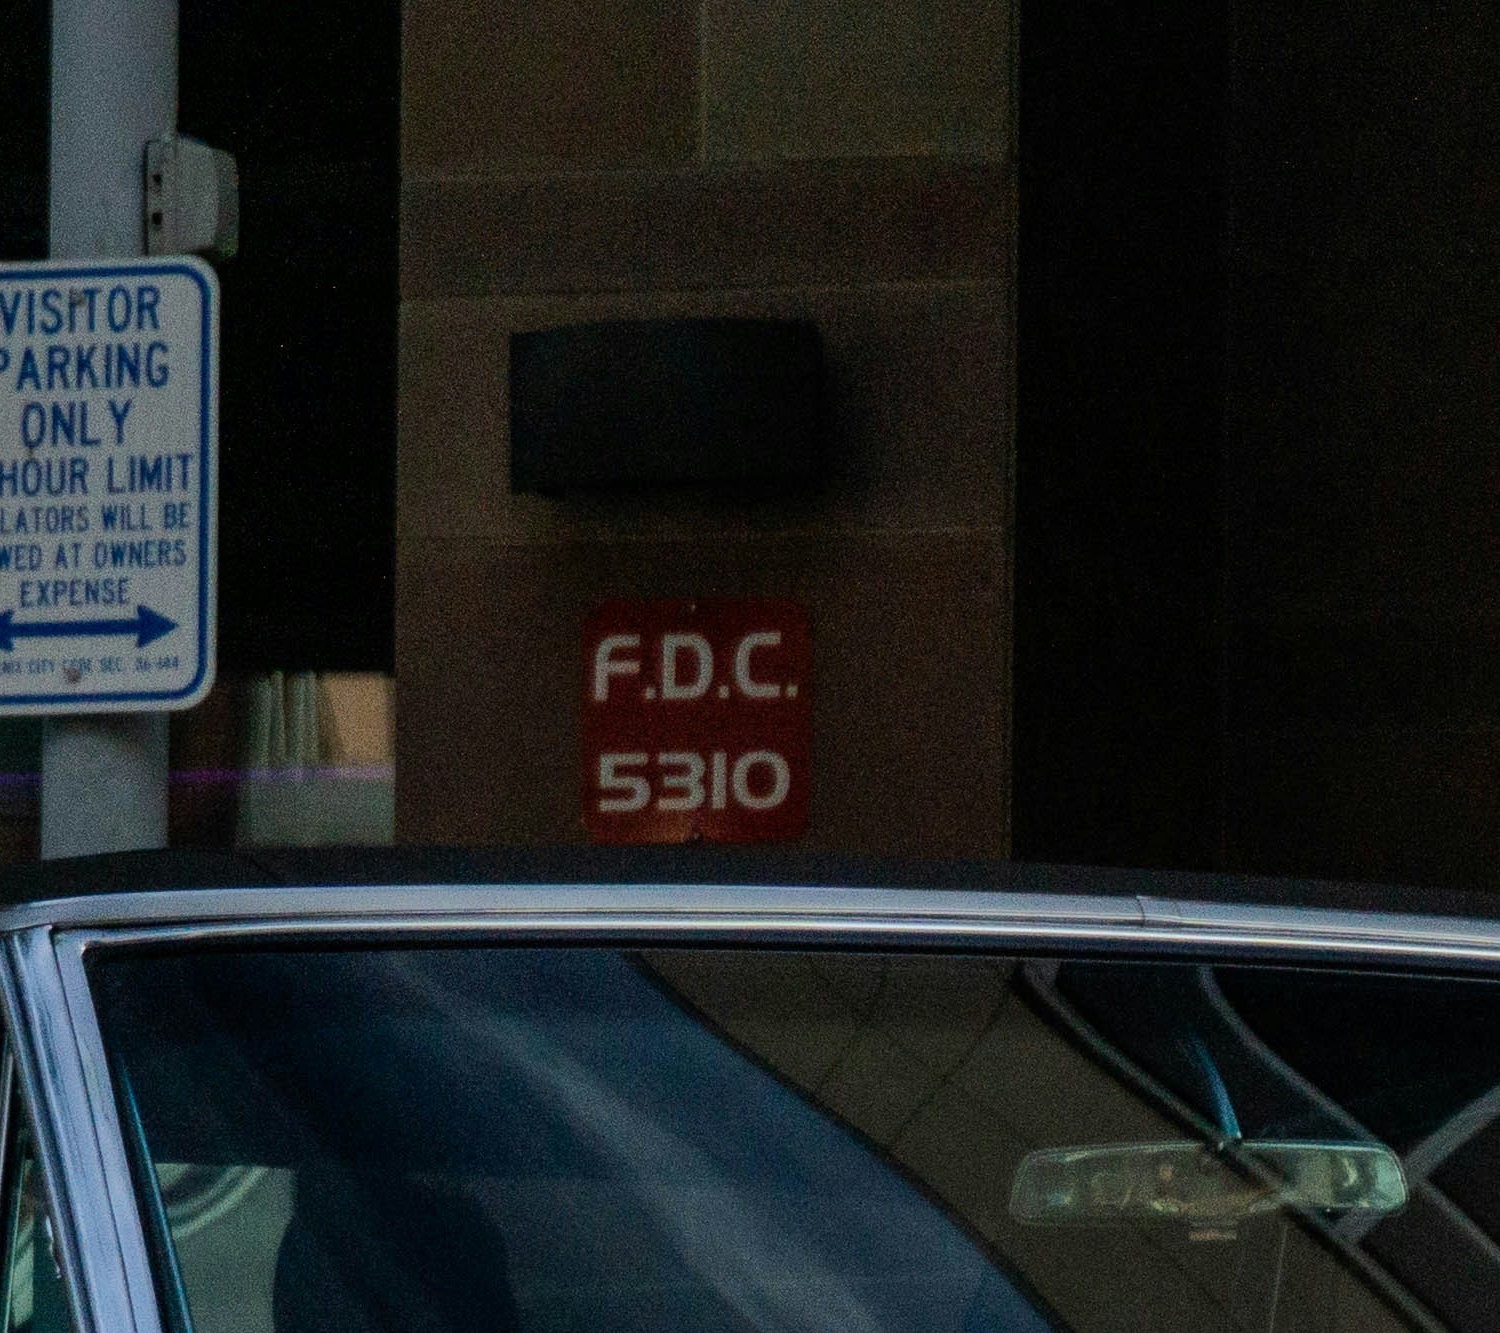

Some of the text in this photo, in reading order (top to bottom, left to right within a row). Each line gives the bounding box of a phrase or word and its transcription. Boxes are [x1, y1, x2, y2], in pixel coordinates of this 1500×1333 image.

[20, 399, 133, 449] ONLY
[106, 453, 194, 495] LIMIT
[102, 503, 153, 532] WILL
[164, 500, 192, 530] BE
[56, 542, 83, 570] AT
[94, 538, 187, 569] OWNERS
[19, 577, 130, 608] EXPENSE
[594, 632, 798, 702] F.D.C.
[598, 749, 791, 812] 5310
